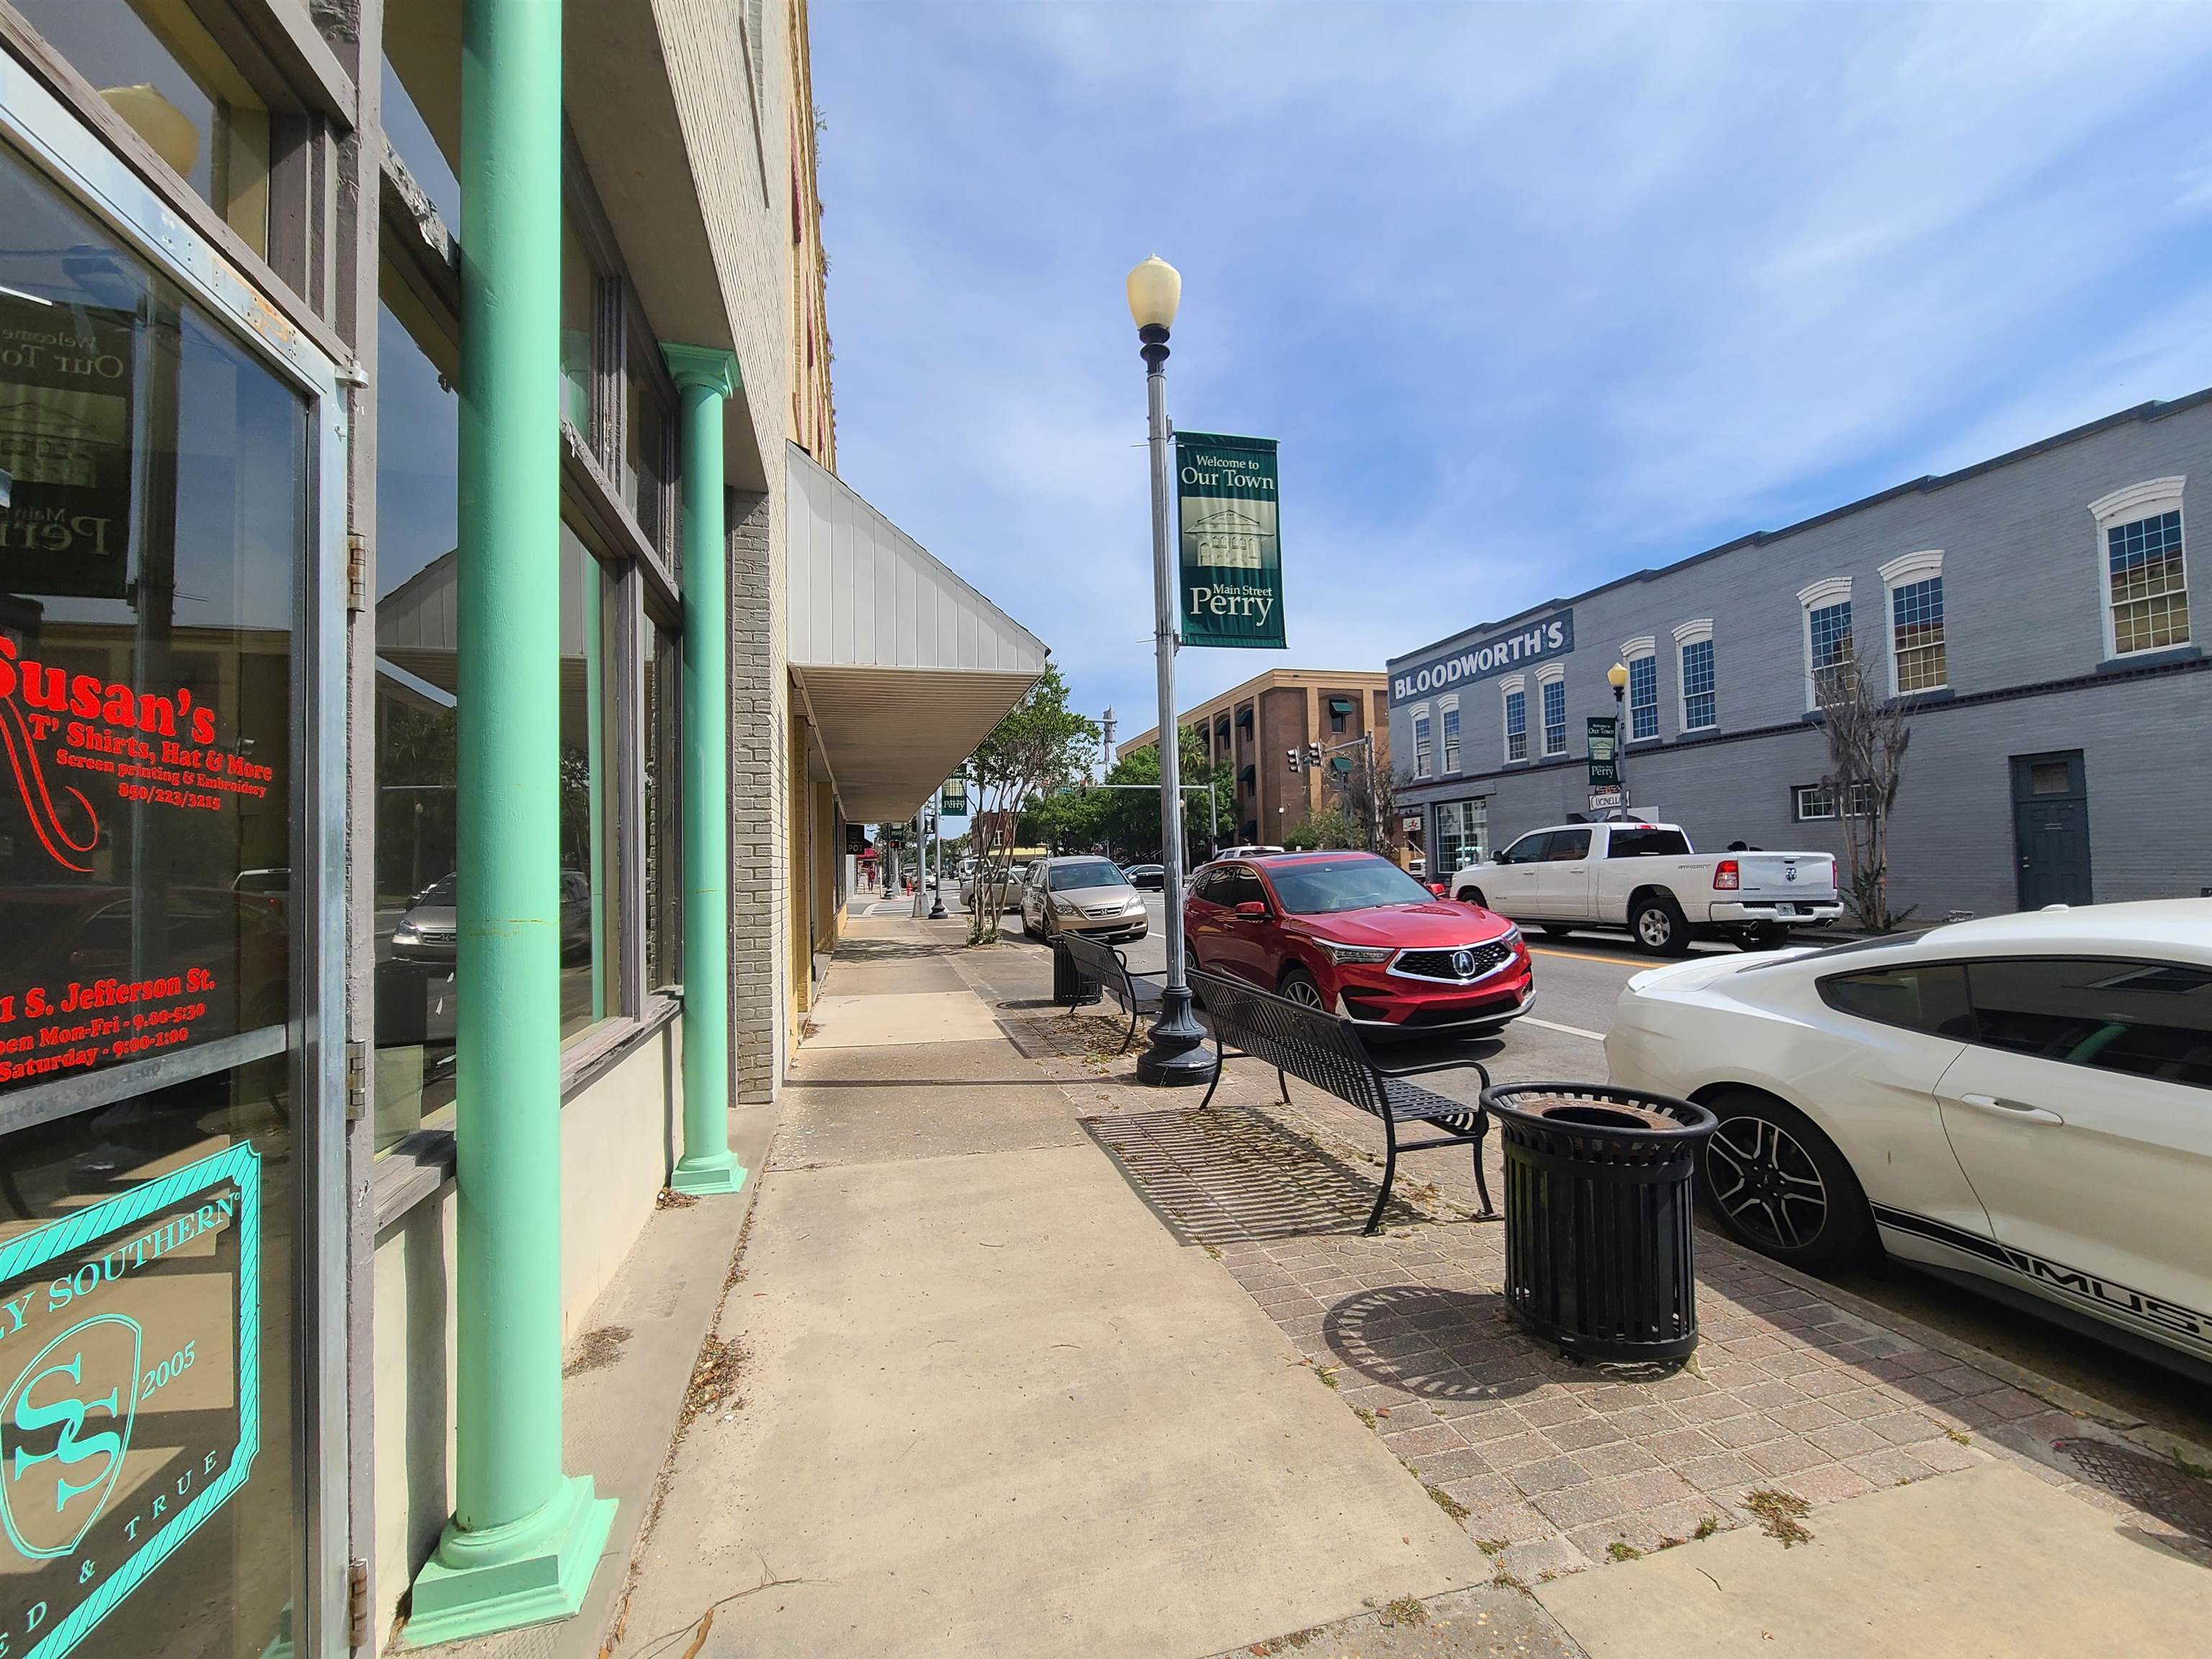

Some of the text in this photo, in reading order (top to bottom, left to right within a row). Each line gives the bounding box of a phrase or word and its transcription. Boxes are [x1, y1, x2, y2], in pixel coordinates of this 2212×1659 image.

[1181, 467, 1275, 490] Our Town
[1196, 454, 1259, 470] Welcome to
[1190, 587, 1274, 626] Perry
[1213, 583, 1272, 596] Main Street
[1395, 621, 1564, 700] BLOODWORTH'S
[56, 749, 268, 798] Screen printing & Embroidery
[66, 722, 156, 765] Shirts,
[161, 740, 202, 768] Hat
[205, 750, 225, 771] &
[227, 753, 273, 781] More
[1591, 765, 1614, 778] Perry
[943, 800, 965, 811] Perry
[24, 986, 54, 1018] S.
[60, 976, 181, 1013] Jefferson
[186, 968, 216, 993] St.
[0, 1047, 99, 1082] Saturday
[112, 1027, 189, 1058] 9:00-1:00
[39, 1015, 120, 1048] Mon-Fri
[48, 1192, 240, 1313] SOUTHERN
[2032, 1259, 2212, 1334] MUS
[140, 1341, 196, 1401] 2005
[79, 1559, 96, 1584] &
[124, 1449, 217, 1542] TRUE
